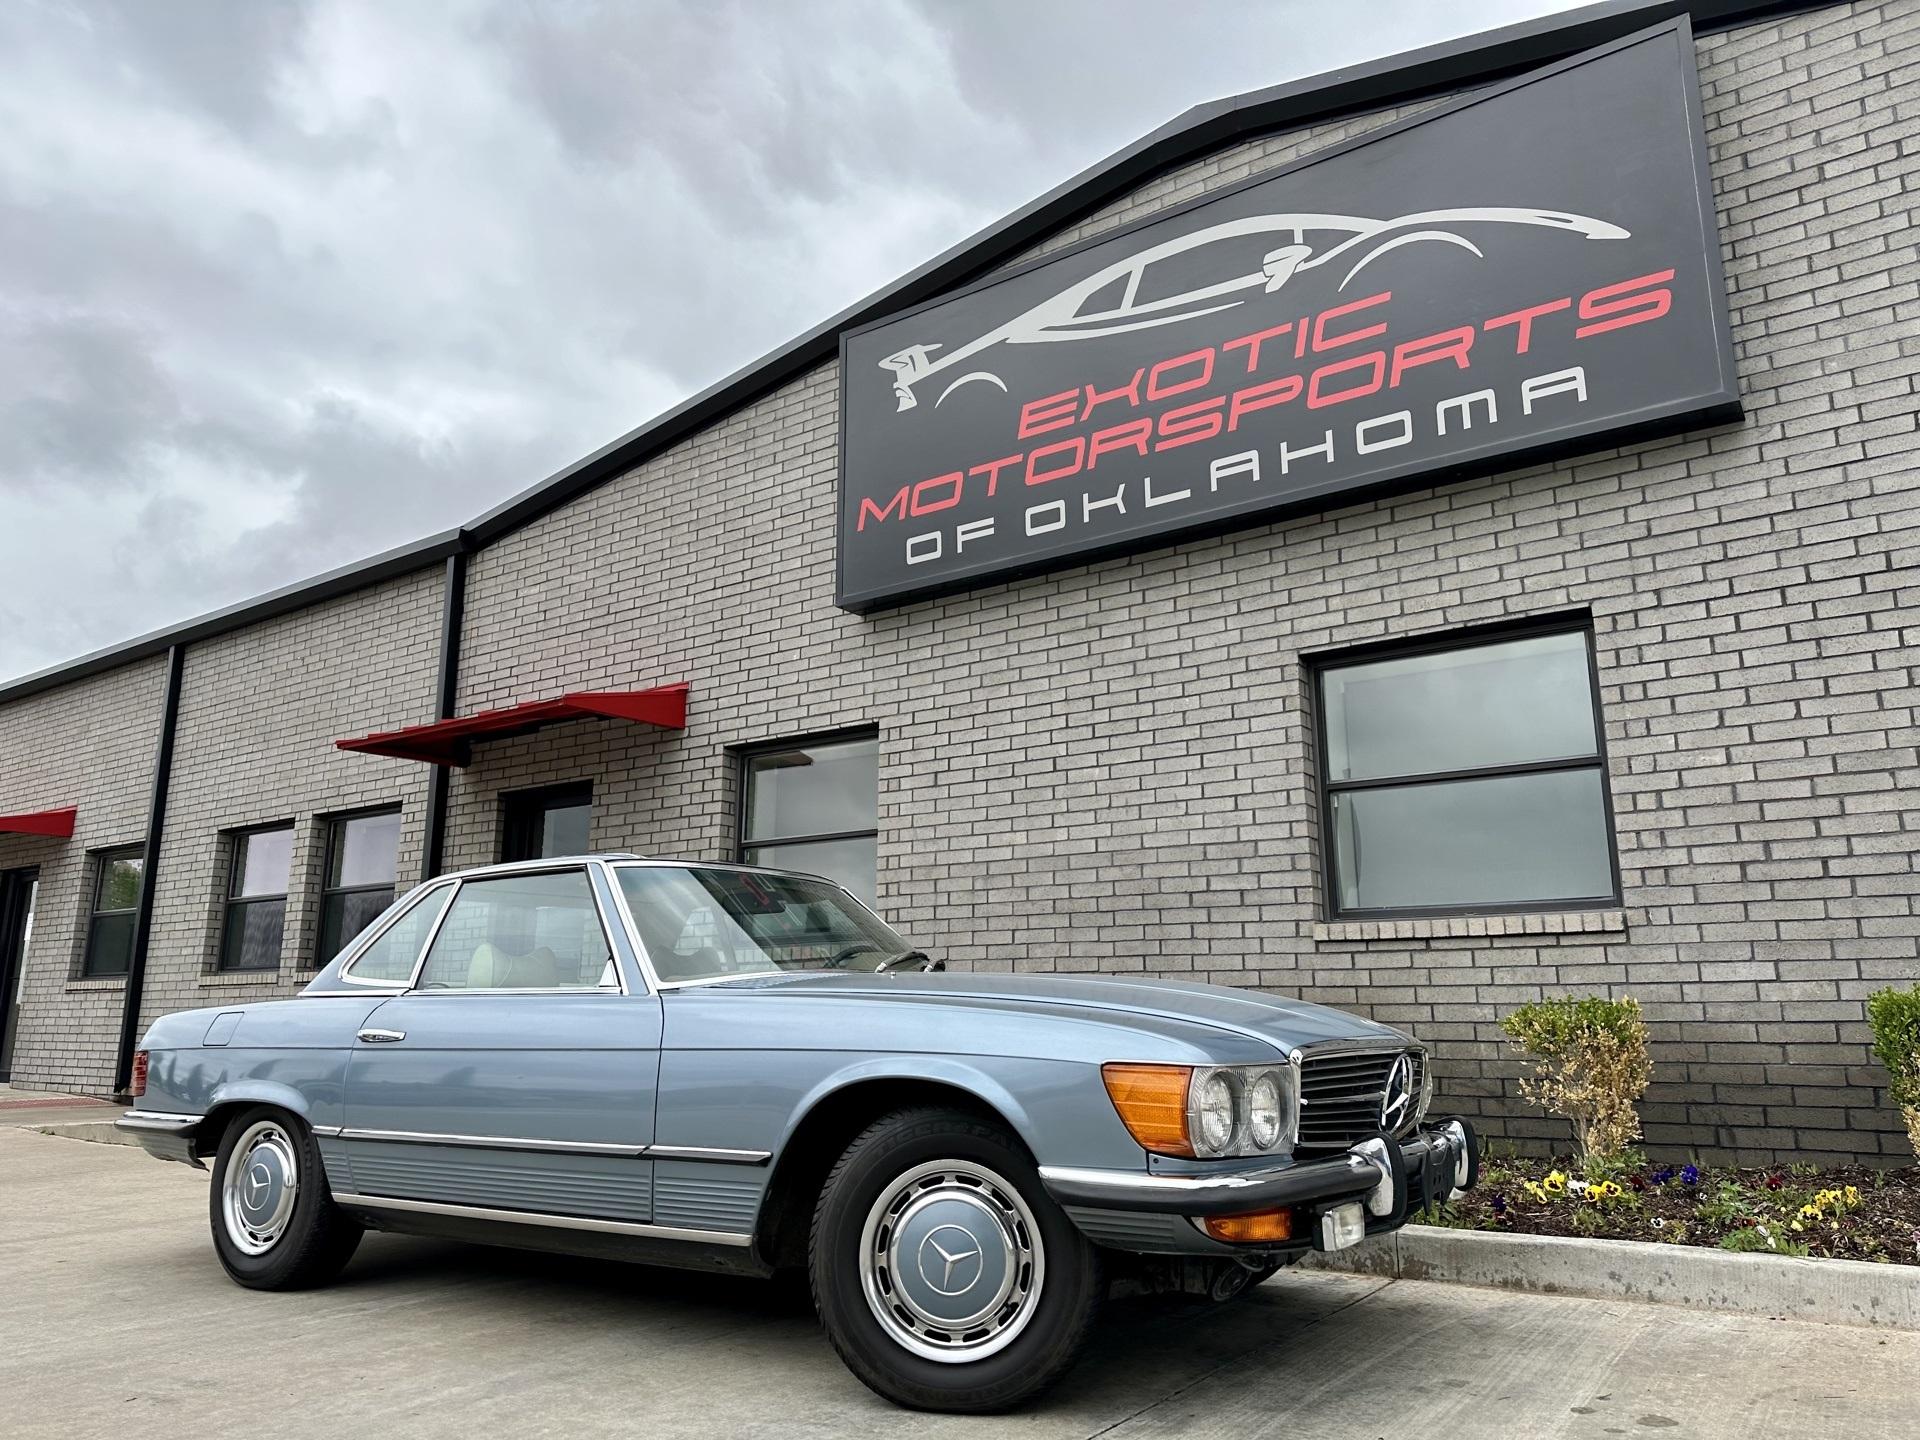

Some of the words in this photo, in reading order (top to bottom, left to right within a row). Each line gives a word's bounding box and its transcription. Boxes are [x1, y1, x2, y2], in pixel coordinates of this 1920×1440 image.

[857, 268, 1676, 532] MOTORSPORTS
[905, 516, 995, 565] OF
[1025, 365, 1588, 537] OKLAHOMA
[1017, 291, 1392, 441] EXOTIC
